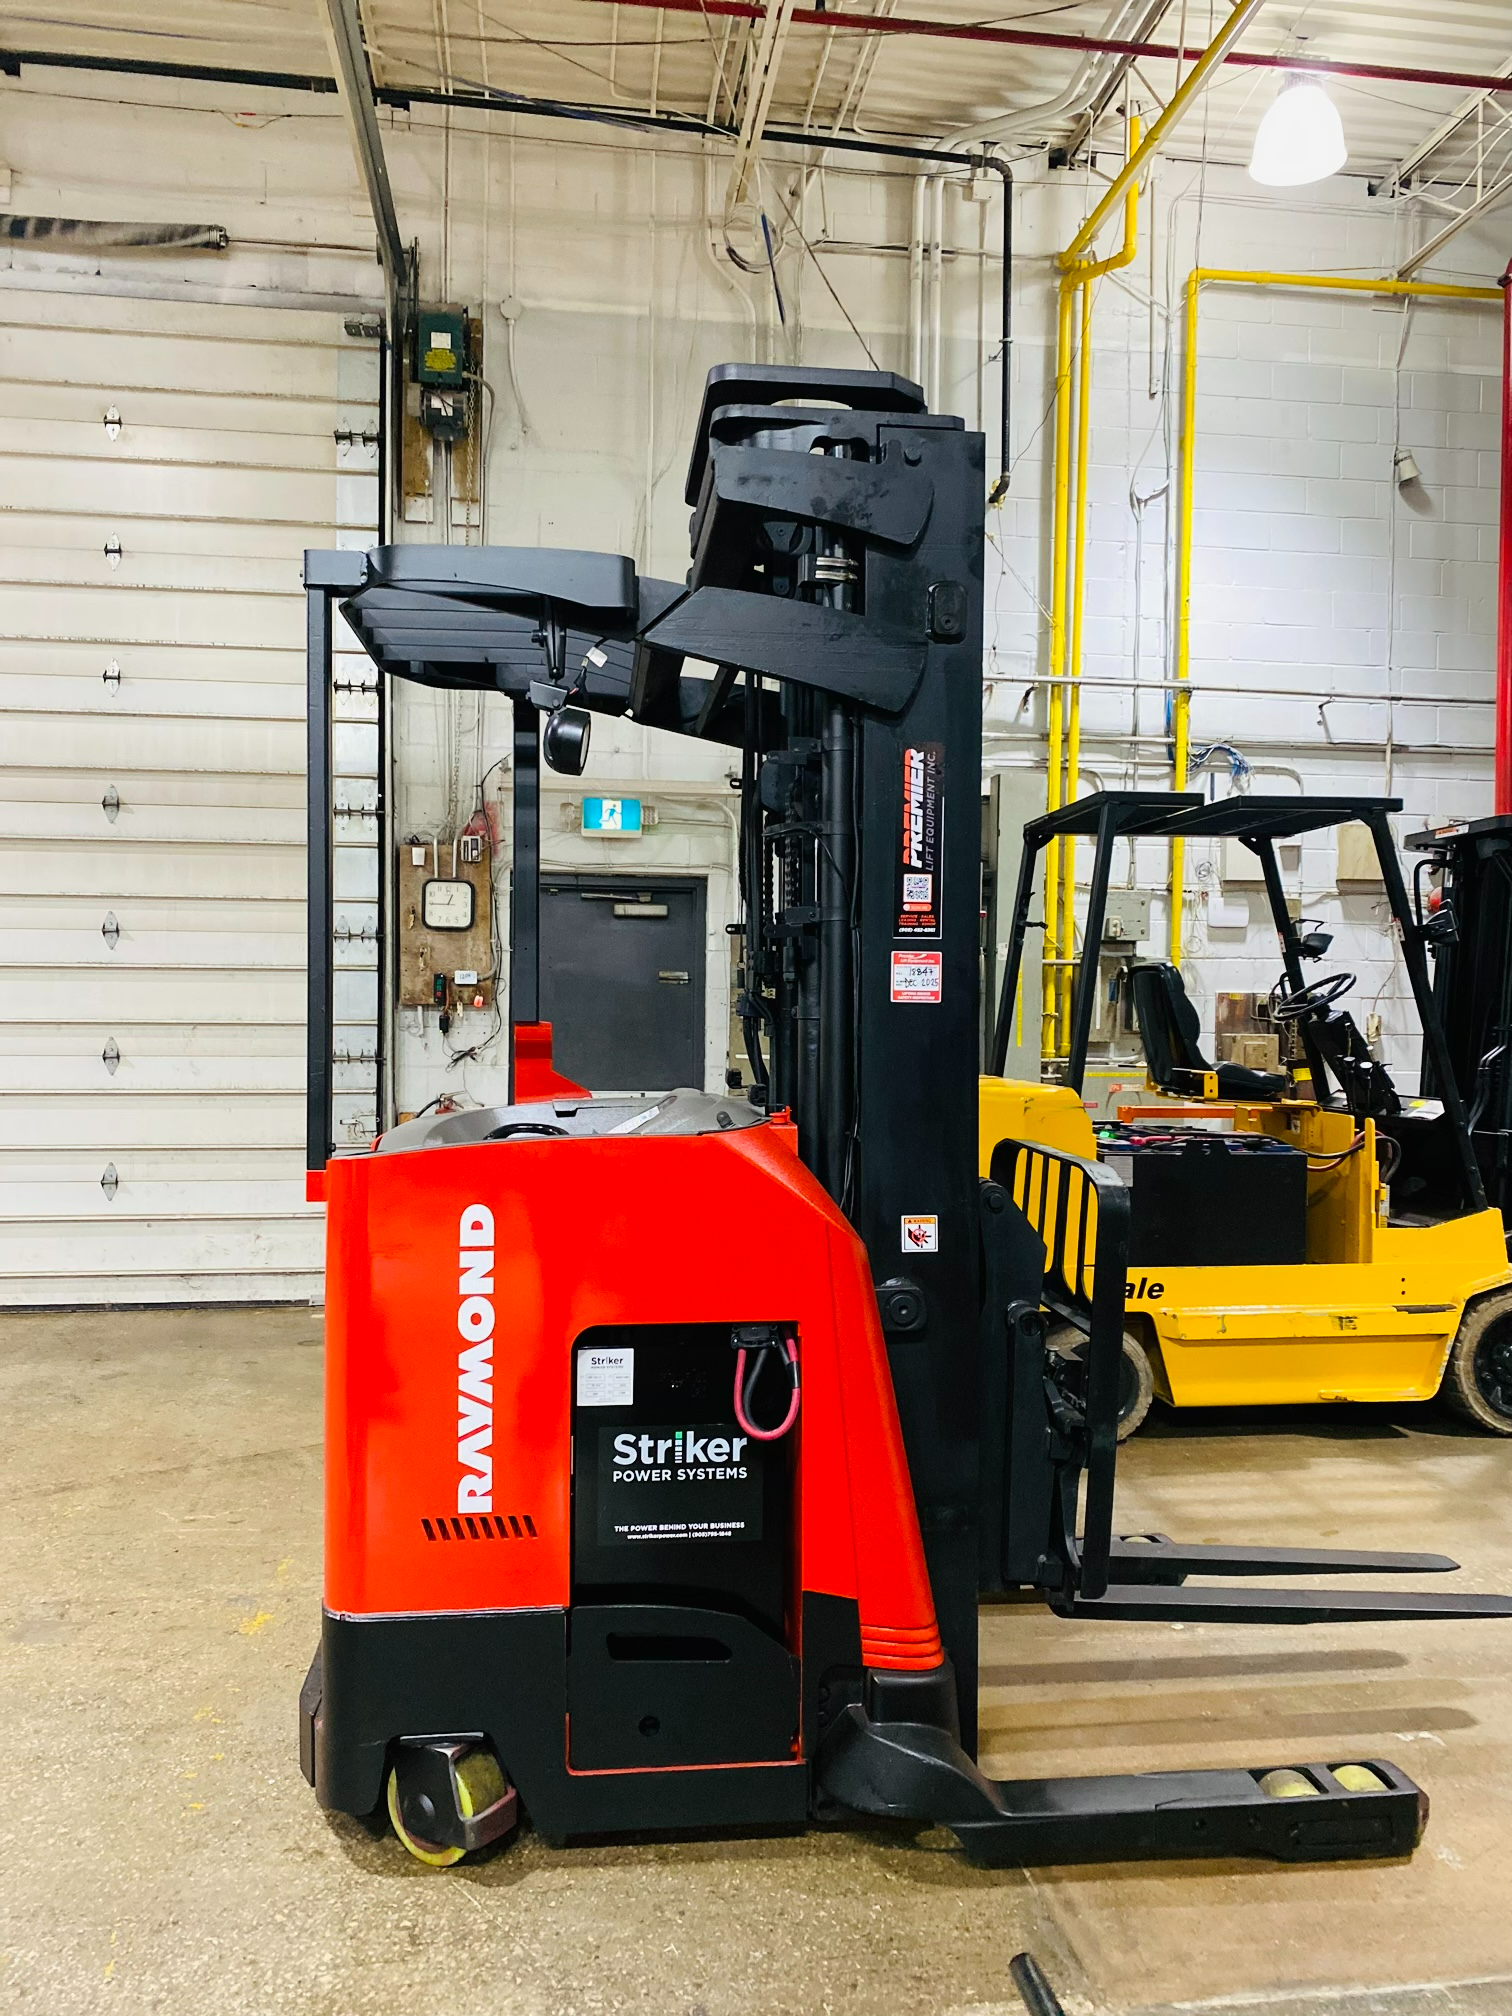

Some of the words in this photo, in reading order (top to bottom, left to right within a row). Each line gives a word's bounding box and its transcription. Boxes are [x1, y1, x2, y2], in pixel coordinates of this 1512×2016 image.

[927, 751, 937, 774] INC.
[903, 748, 925, 869] PREMIER
[925, 777, 936, 844] EQUIPMENT
[925, 848, 934, 871] LIFT
[921, 978, 939, 987] 2025
[1125, 1277, 1165, 1300] ale
[458, 1204, 495, 1514] RAYMOND
[591, 1356, 624, 1366] Striker
[613, 1430, 748, 1465] Striker
[613, 1469, 672, 1482] POWER
[676, 1467, 748, 1480] SYSTEMS
[614, 1525, 629, 1533] THE
[630, 1524, 658, 1532] POWER
[659, 1523, 687, 1531] BEHIND
[688, 1522, 709, 1530] YOUR
[709, 1521, 746, 1529] BUSINESS
